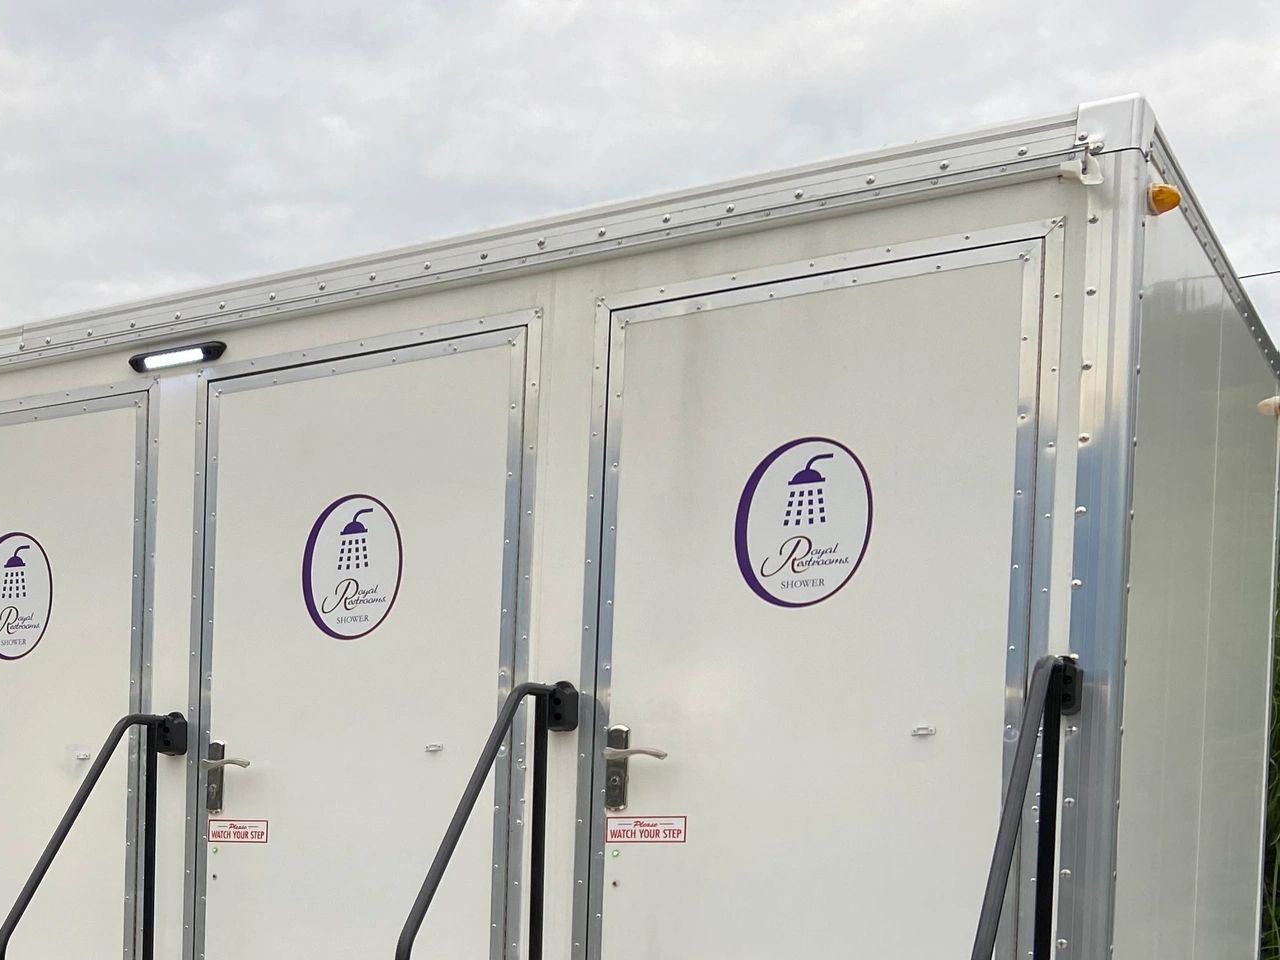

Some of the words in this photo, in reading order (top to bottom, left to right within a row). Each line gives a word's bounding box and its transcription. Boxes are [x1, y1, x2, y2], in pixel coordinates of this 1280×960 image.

[780, 578, 825, 589] SHOWER
[211, 830, 231, 839] WATCH
[233, 830, 249, 839] YOUR
[250, 830, 265, 839] STEP
[610, 829, 636, 839] WATCH
[639, 829, 660, 839] YOUR
[663, 829, 682, 839] STEP
